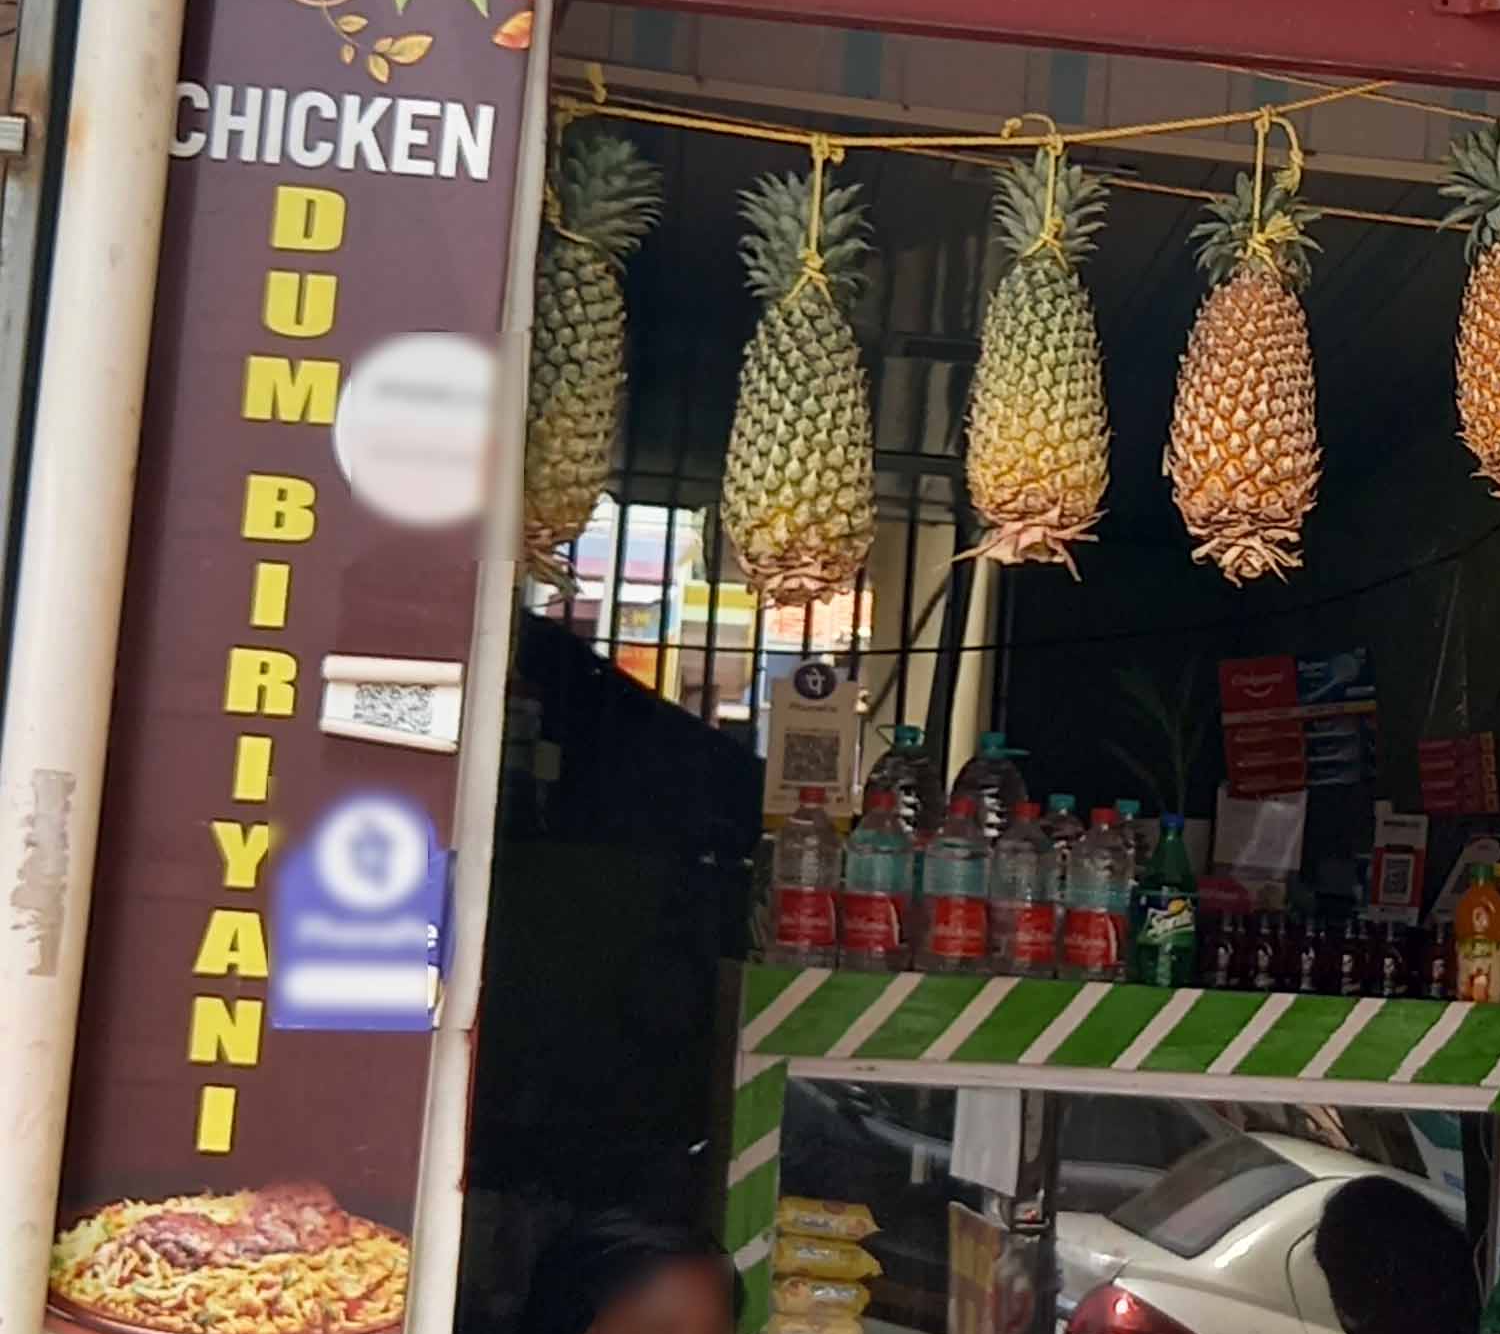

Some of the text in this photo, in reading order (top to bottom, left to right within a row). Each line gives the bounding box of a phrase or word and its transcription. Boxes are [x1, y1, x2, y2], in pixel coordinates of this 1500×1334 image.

[169, 81, 498, 182] CHICKEN
[240, 184, 348, 426] DUM
[187, 473, 319, 1154] BIRIYANI
